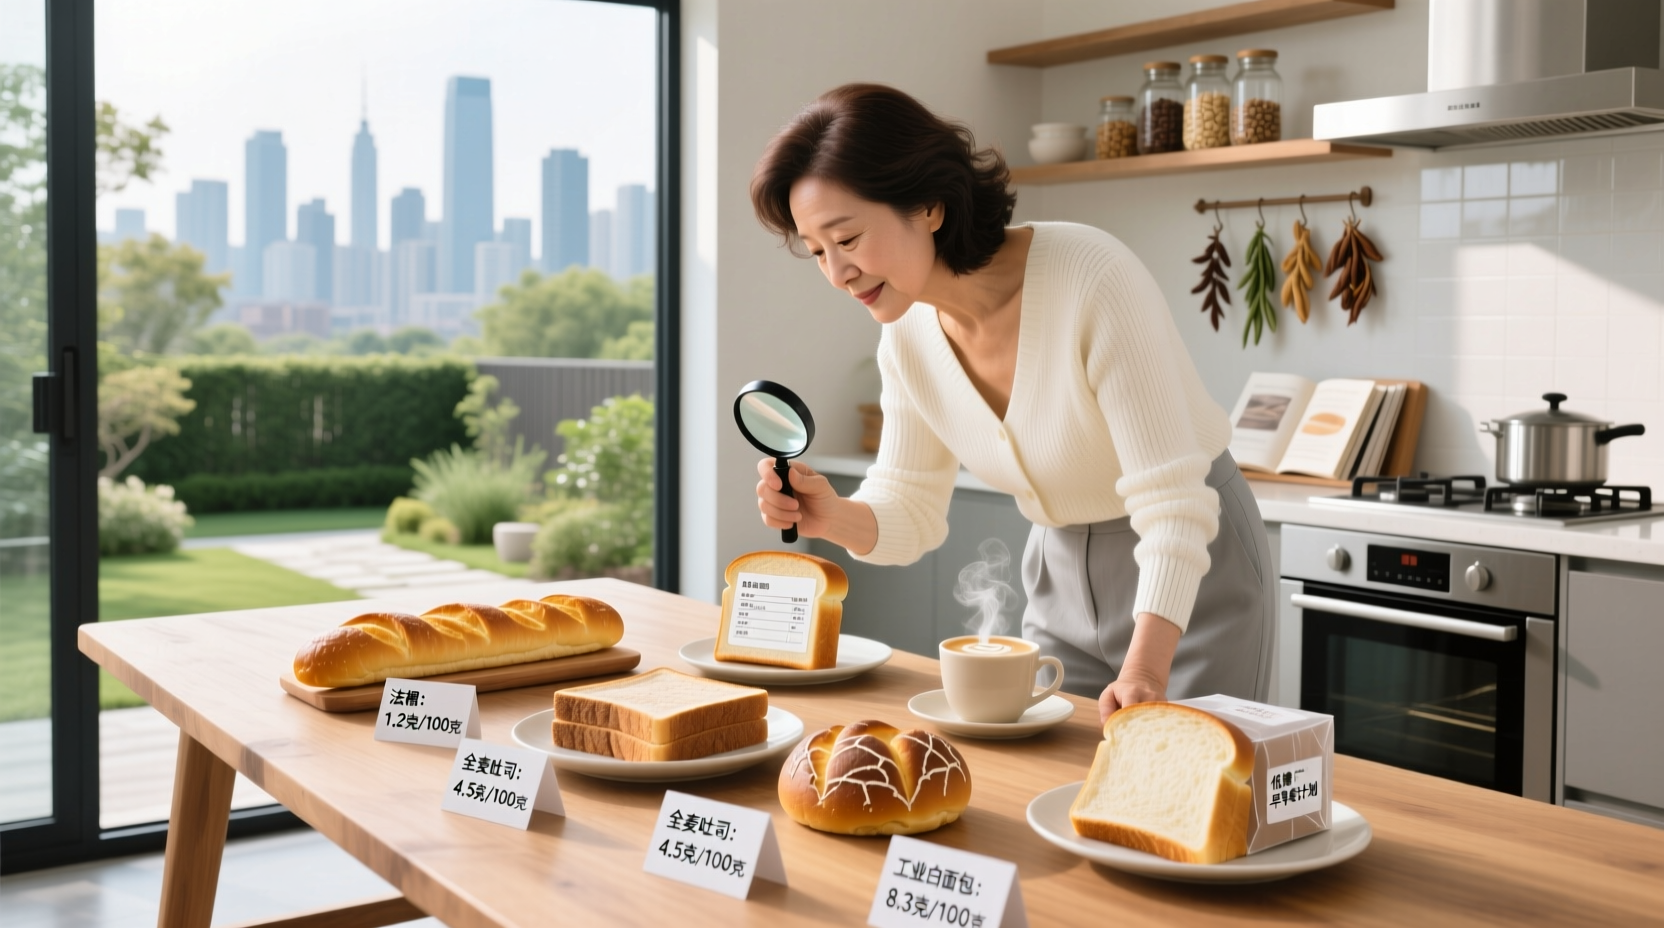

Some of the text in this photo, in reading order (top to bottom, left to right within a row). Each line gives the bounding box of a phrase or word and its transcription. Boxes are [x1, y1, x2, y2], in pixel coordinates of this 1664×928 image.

[666, 809, 737, 841] 全麦吐司：
[658, 838, 747, 878] 4.5克/100克
[893, 858, 982, 896] 工业白面包：
